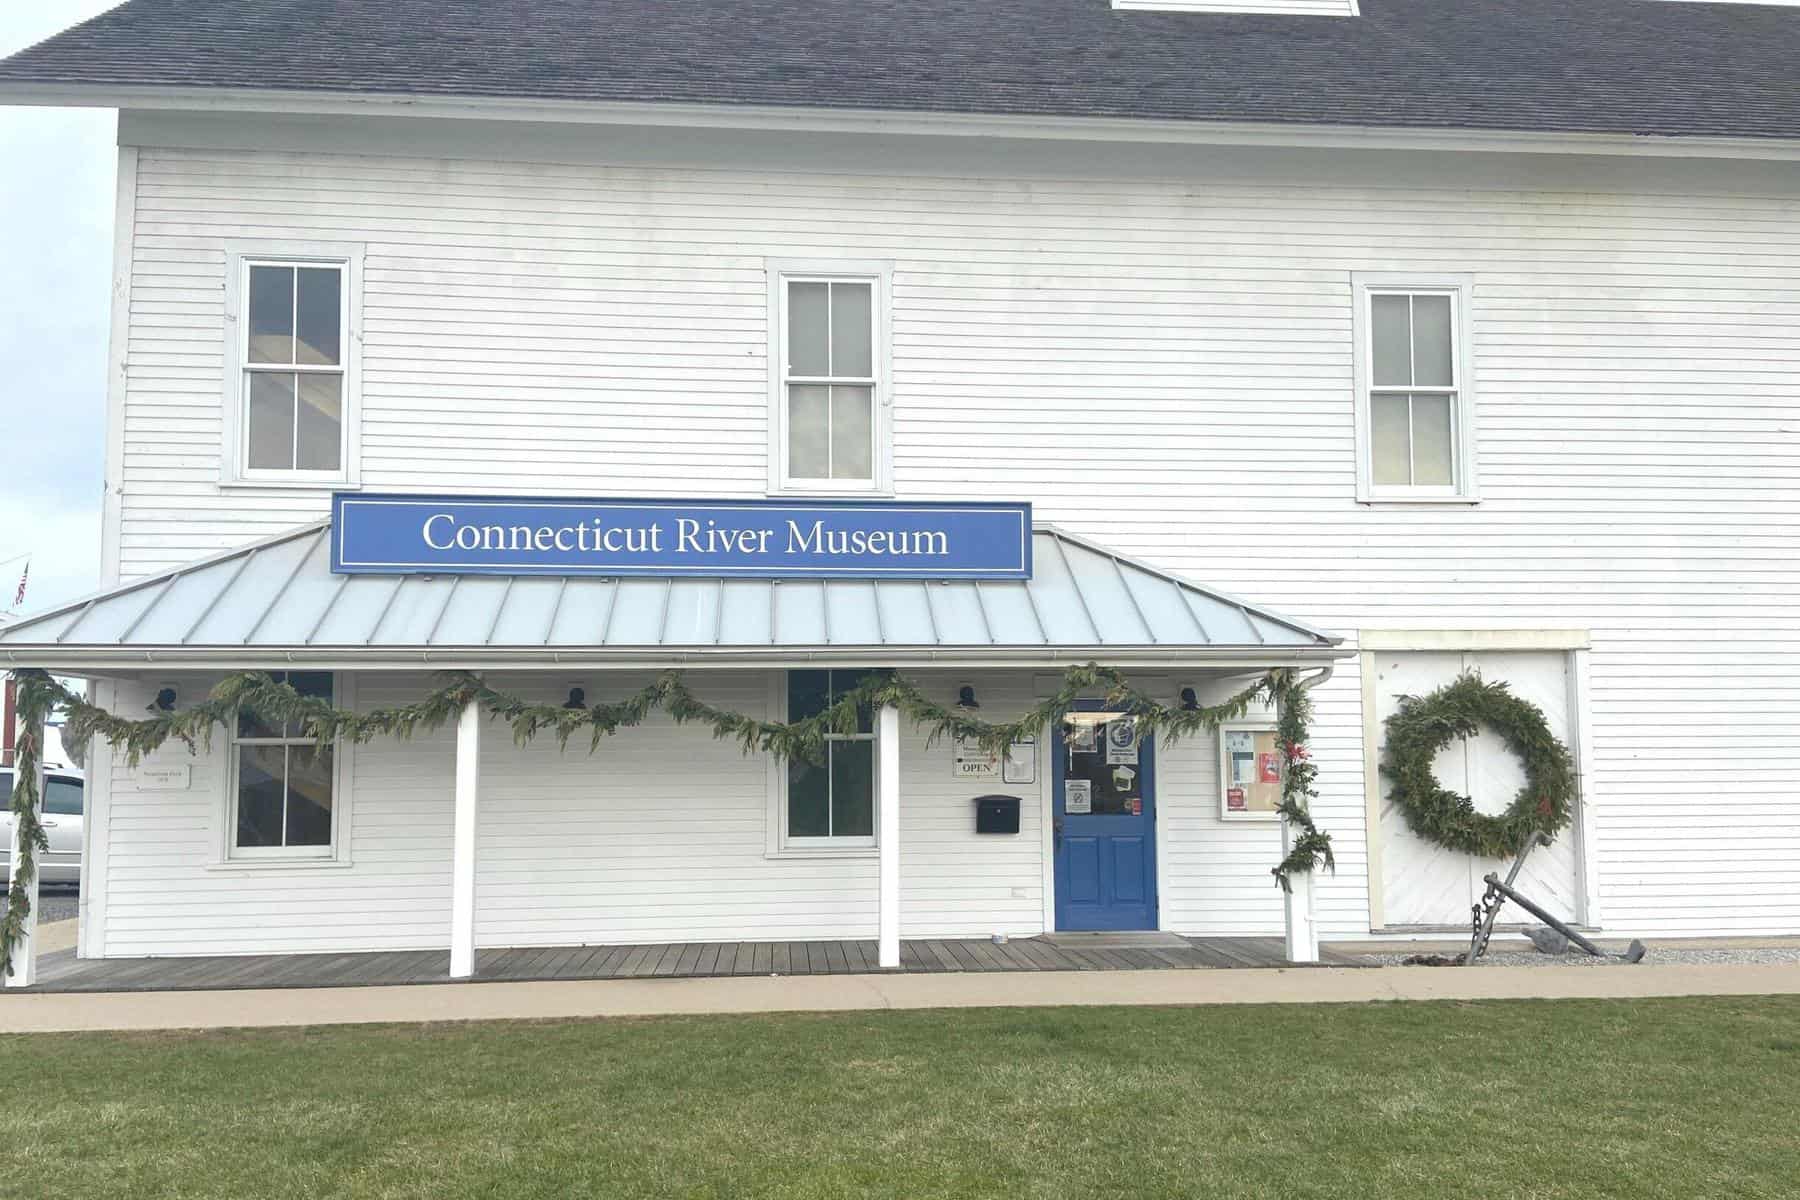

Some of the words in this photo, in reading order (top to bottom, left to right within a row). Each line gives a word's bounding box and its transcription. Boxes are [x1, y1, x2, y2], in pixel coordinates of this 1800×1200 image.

[422, 513, 662, 553] Connecticut
[675, 518, 773, 553] River
[784, 520, 949, 555] Museum
[963, 764, 991, 772] OPEN
